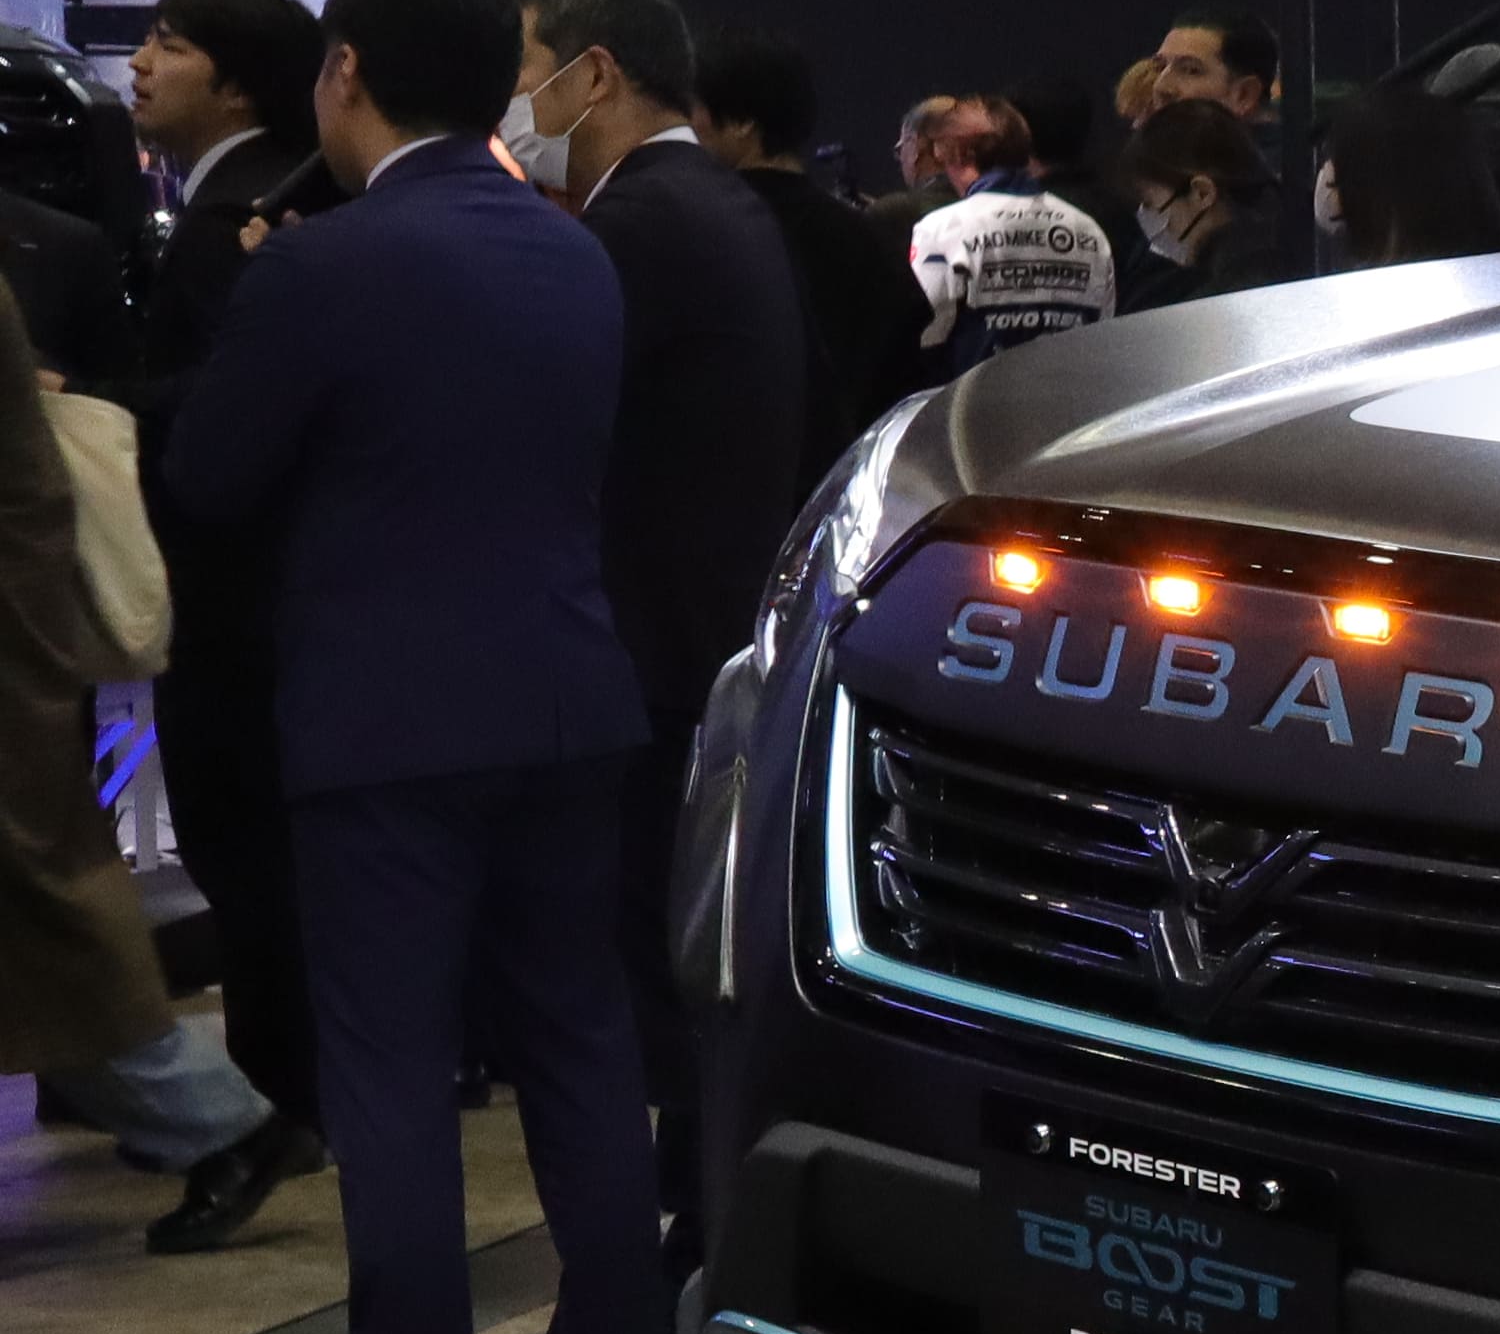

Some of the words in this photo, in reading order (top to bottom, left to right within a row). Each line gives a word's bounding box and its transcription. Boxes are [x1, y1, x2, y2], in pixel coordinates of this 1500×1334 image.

[1069, 1136, 1242, 1199] FORESTER
[1085, 1194, 1224, 1249] SUBARU
[1017, 1209, 1297, 1321] BOOST
[1103, 1289, 1205, 1334] GEAR
